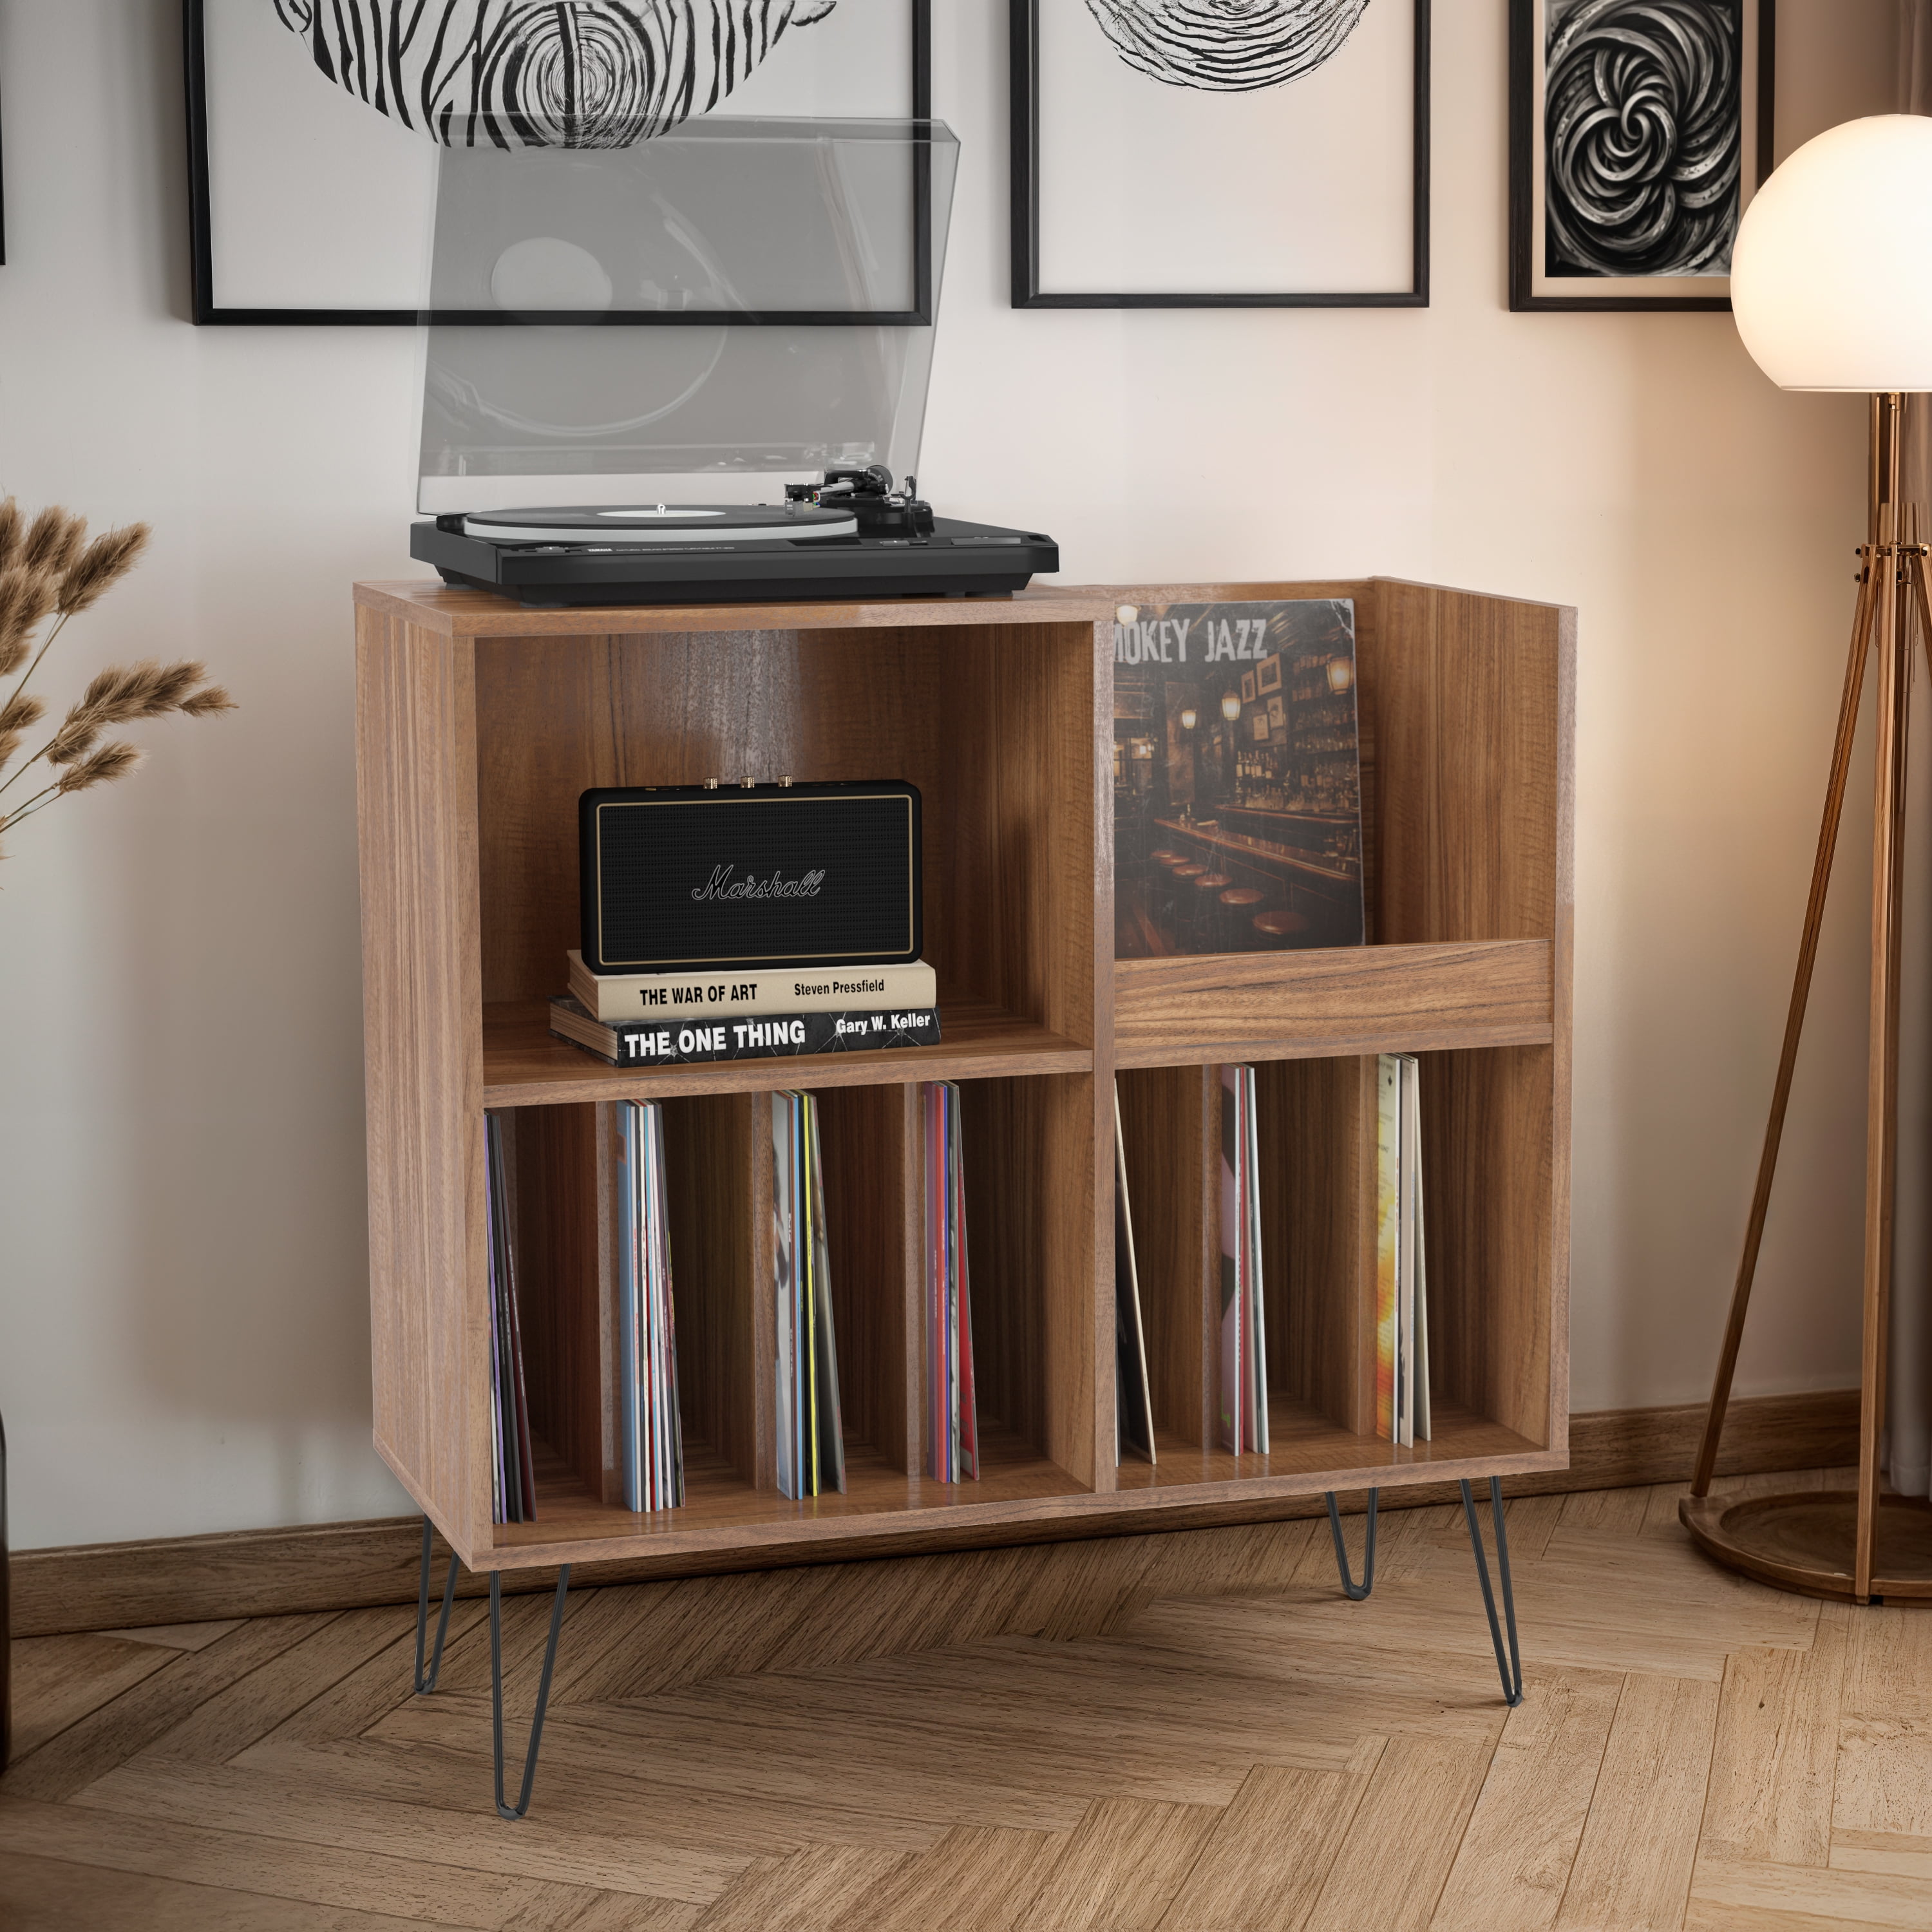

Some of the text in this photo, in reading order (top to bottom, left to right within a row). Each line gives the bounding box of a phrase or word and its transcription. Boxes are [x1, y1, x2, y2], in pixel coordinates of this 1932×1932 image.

[1113, 619, 1267, 665] MOKEY JAZZ
[691, 864, 826, 900] Marshall
[639, 984, 757, 1005] THE WAR OF ART
[795, 979, 884, 996] Steven Pressfield
[624, 1019, 805, 1058] THE ONE THING
[837, 1012, 931, 1036] Gary W. Keller
